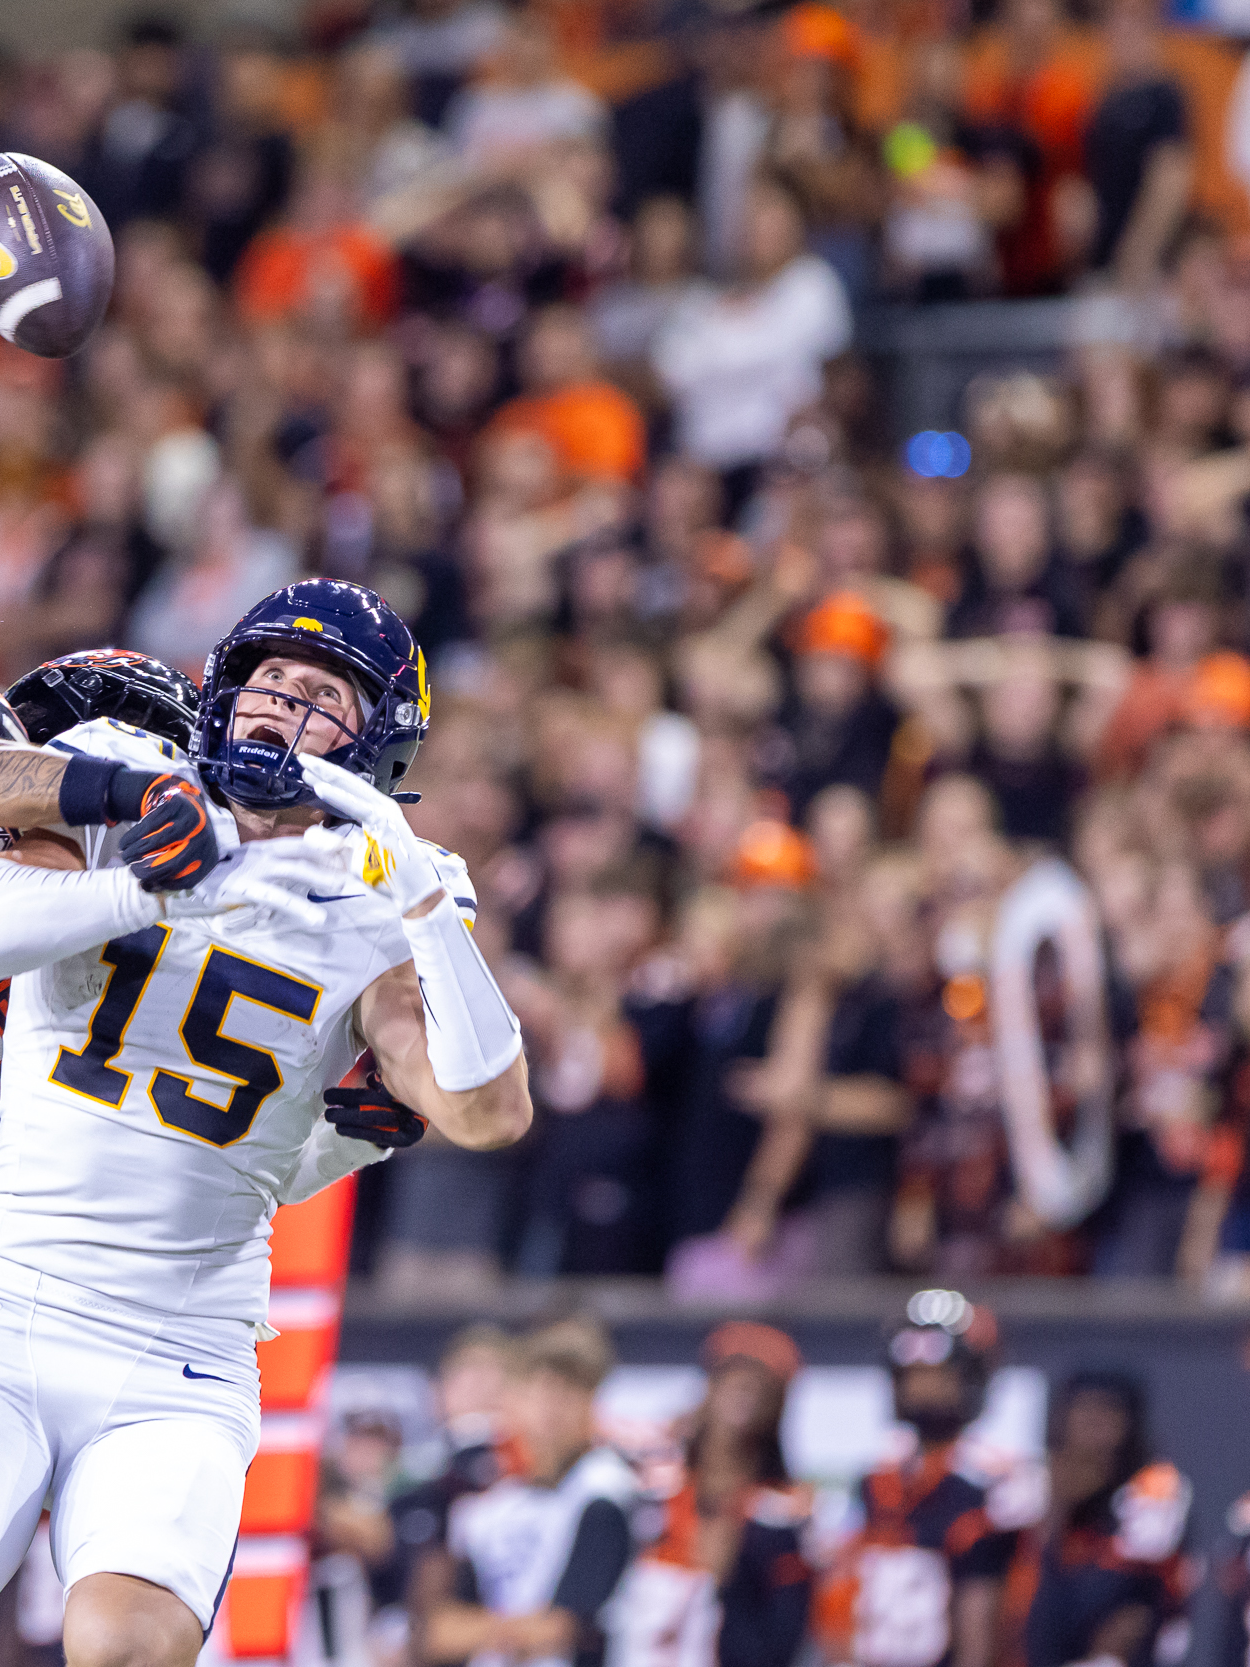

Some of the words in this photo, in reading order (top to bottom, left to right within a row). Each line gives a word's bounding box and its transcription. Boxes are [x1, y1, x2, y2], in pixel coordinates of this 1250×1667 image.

[52, 189, 93, 231] Cal
[238, 745, 280, 761] Riddell
[47, 921, 325, 1150] 15
